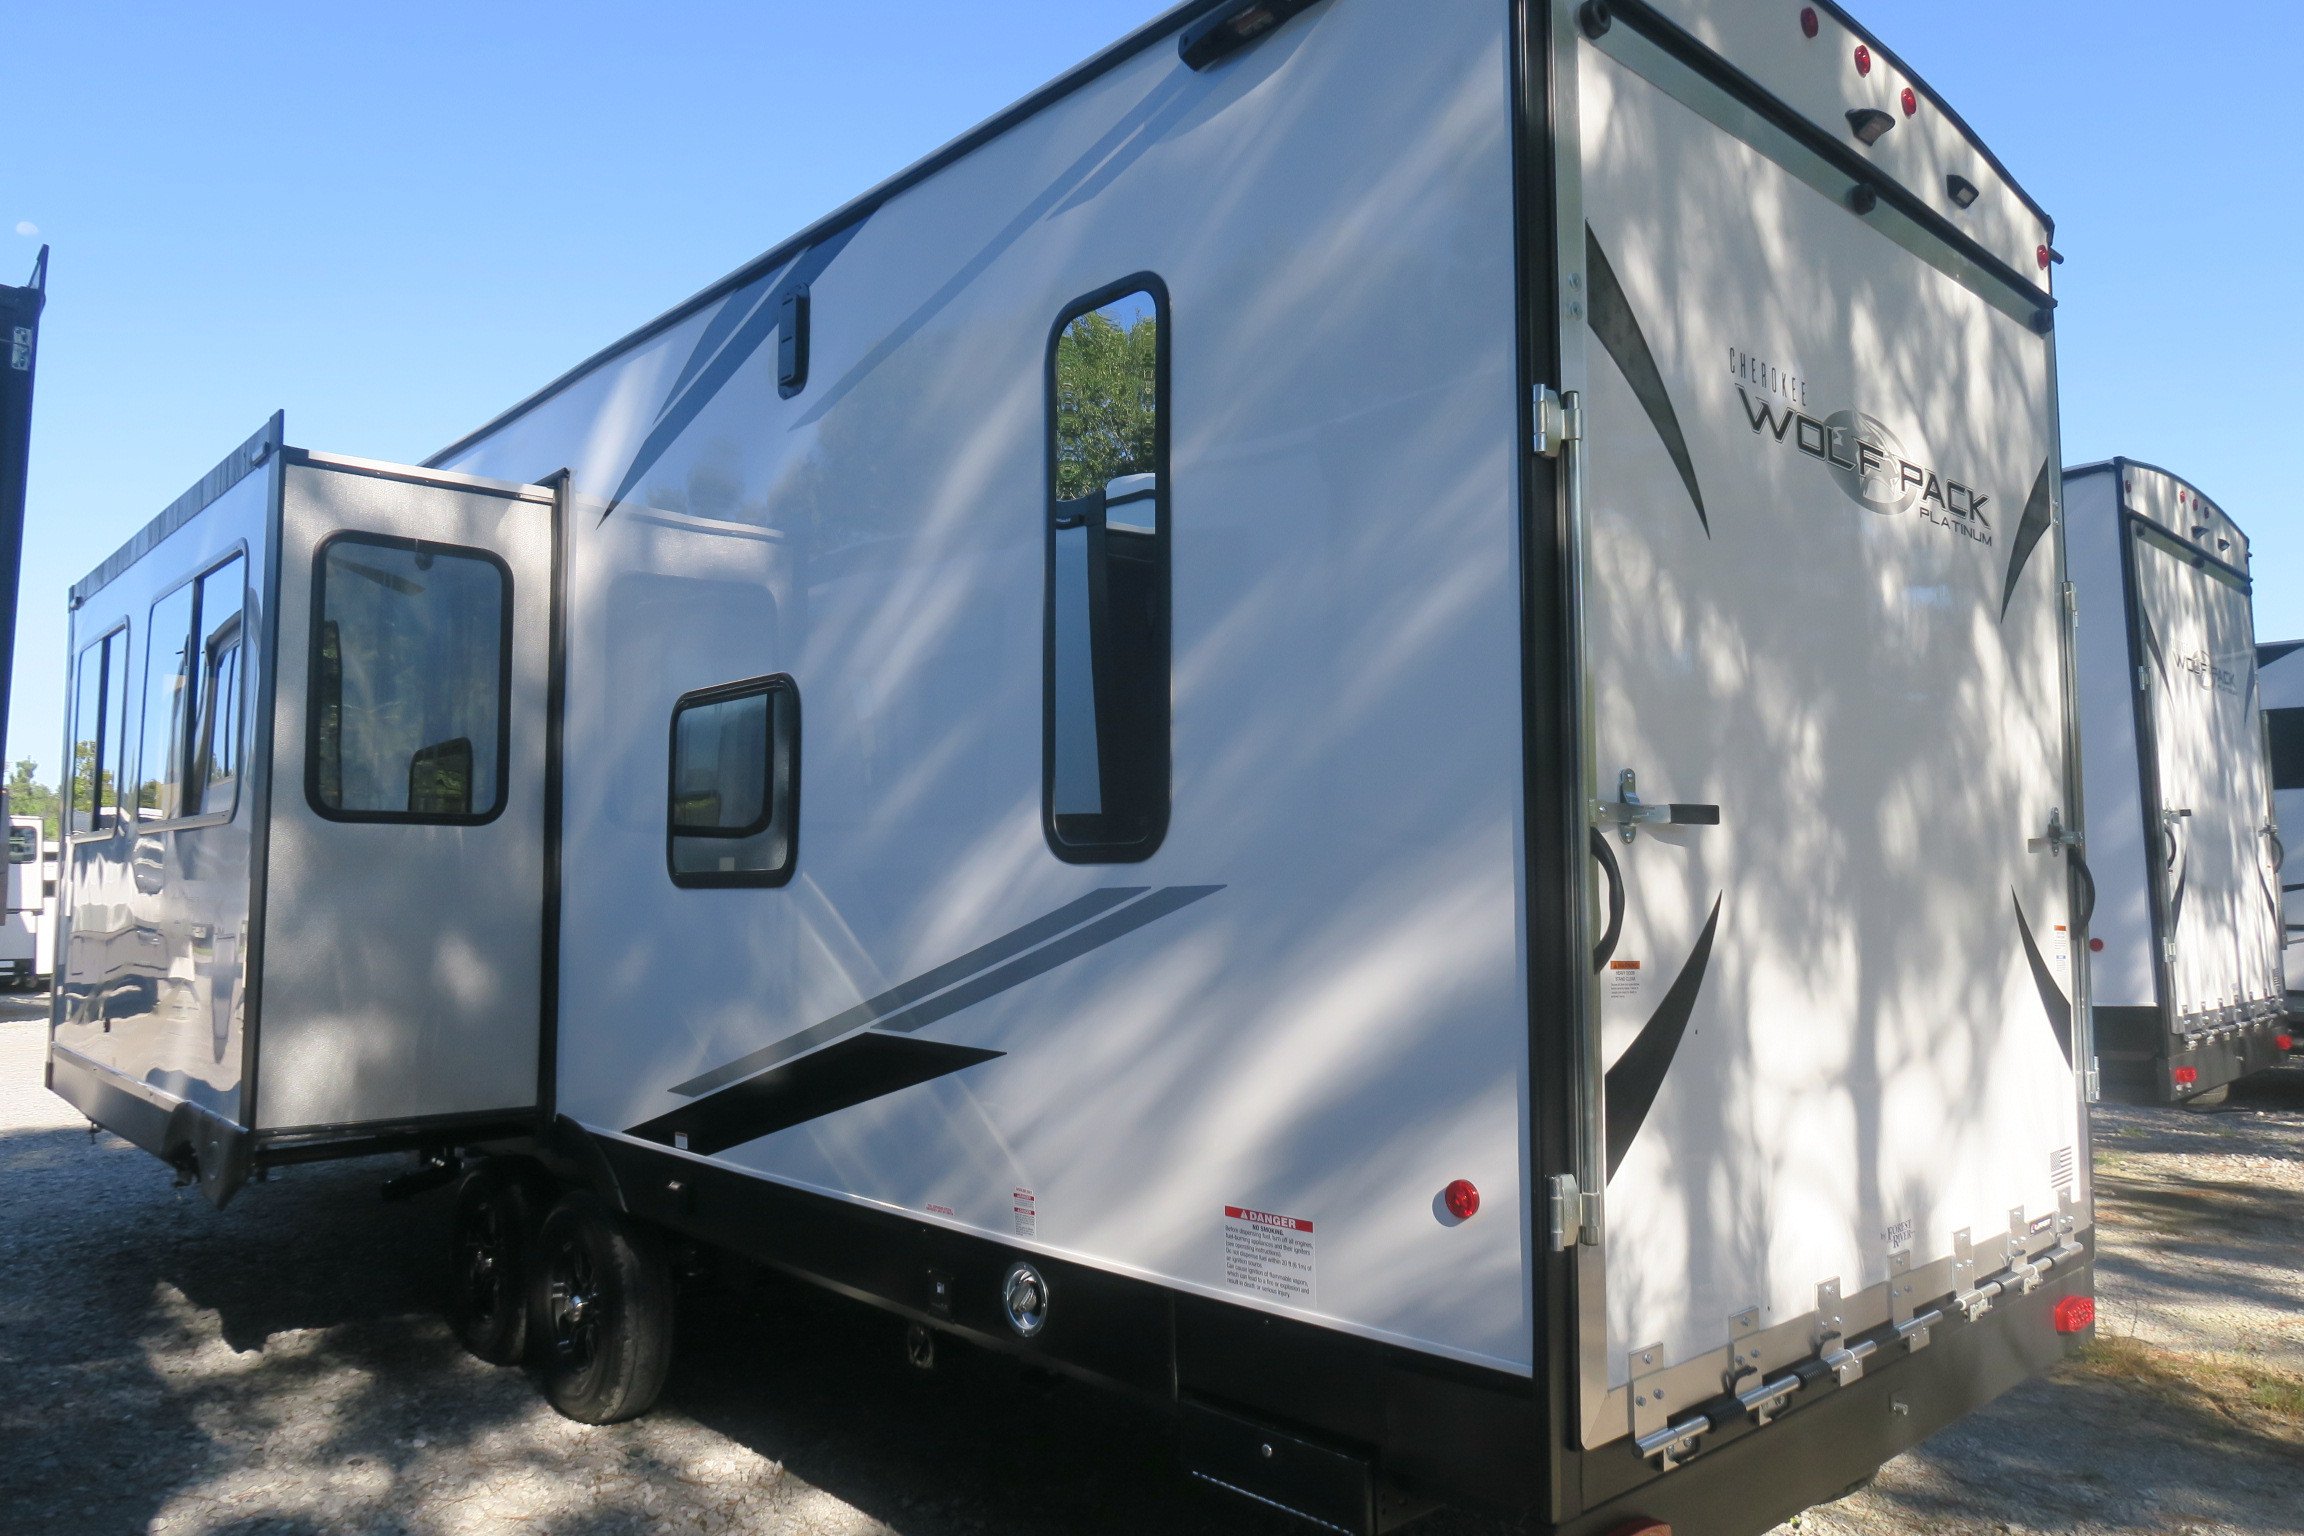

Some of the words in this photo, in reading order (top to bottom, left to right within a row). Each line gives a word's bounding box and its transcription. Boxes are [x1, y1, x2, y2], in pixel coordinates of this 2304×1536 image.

[1729, 347, 1807, 407] CHEROKEE
[1734, 382, 1885, 478] WOLF
[1898, 457, 1992, 530] PACK
[1919, 506, 1993, 547] PLATINUM
[1249, 1211, 1296, 1229] DANGER
